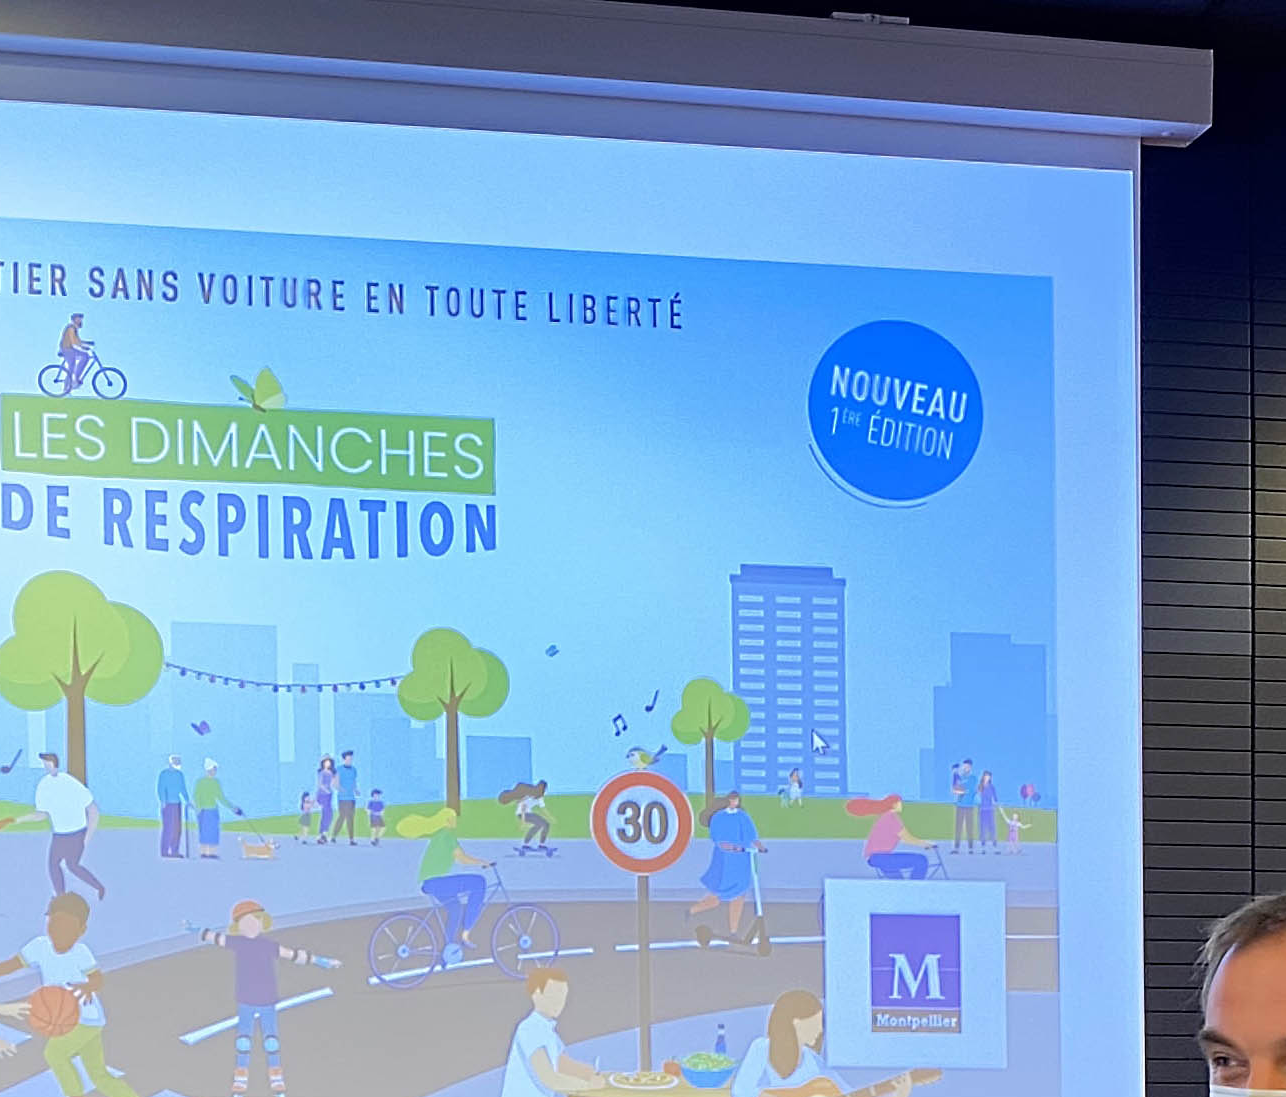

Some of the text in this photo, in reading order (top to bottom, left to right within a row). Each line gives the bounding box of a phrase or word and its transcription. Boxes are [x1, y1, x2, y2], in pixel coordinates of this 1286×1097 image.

[88, 266, 179, 302] SANS
[198, 272, 345, 312] VOITURE
[366, 282, 405, 315] EN
[425, 285, 528, 321] TOUTE
[548, 291, 683, 330] LIBERTÉ
[830, 364, 967, 423] NOUVEAU
[14, 411, 484, 479] LES DIMANCHES
[867, 408, 953, 460] ÉDITION
[1, 483, 497, 560] DE RESPIRATION
[616, 801, 669, 844] 30
[888, 953, 945, 1000] M
[876, 1013, 958, 1030] Montpellier
